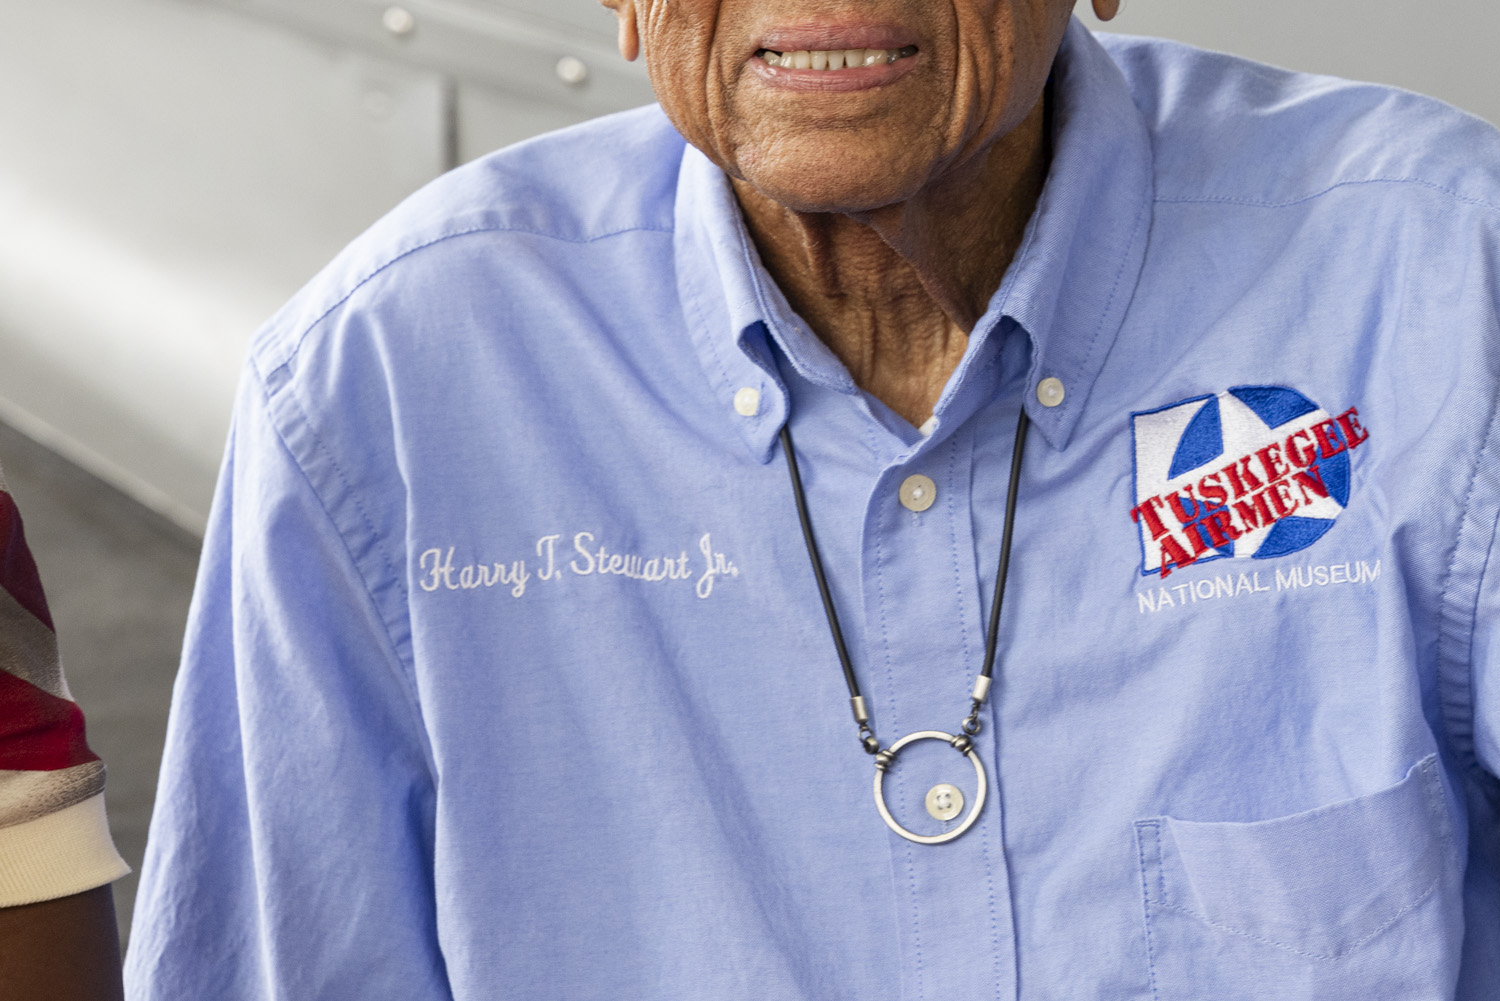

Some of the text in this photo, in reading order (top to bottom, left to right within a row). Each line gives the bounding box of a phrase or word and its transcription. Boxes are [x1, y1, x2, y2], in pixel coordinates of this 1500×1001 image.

[1130, 406, 1370, 541] TUSKEGEE
[419, 546, 531, 598] Harry
[570, 531, 693, 582] Stewart
[696, 532, 739, 599] Jr.
[1160, 465, 1330, 579] AIRMEN
[1136, 559, 1382, 614] NATIONAL MUSEUM
